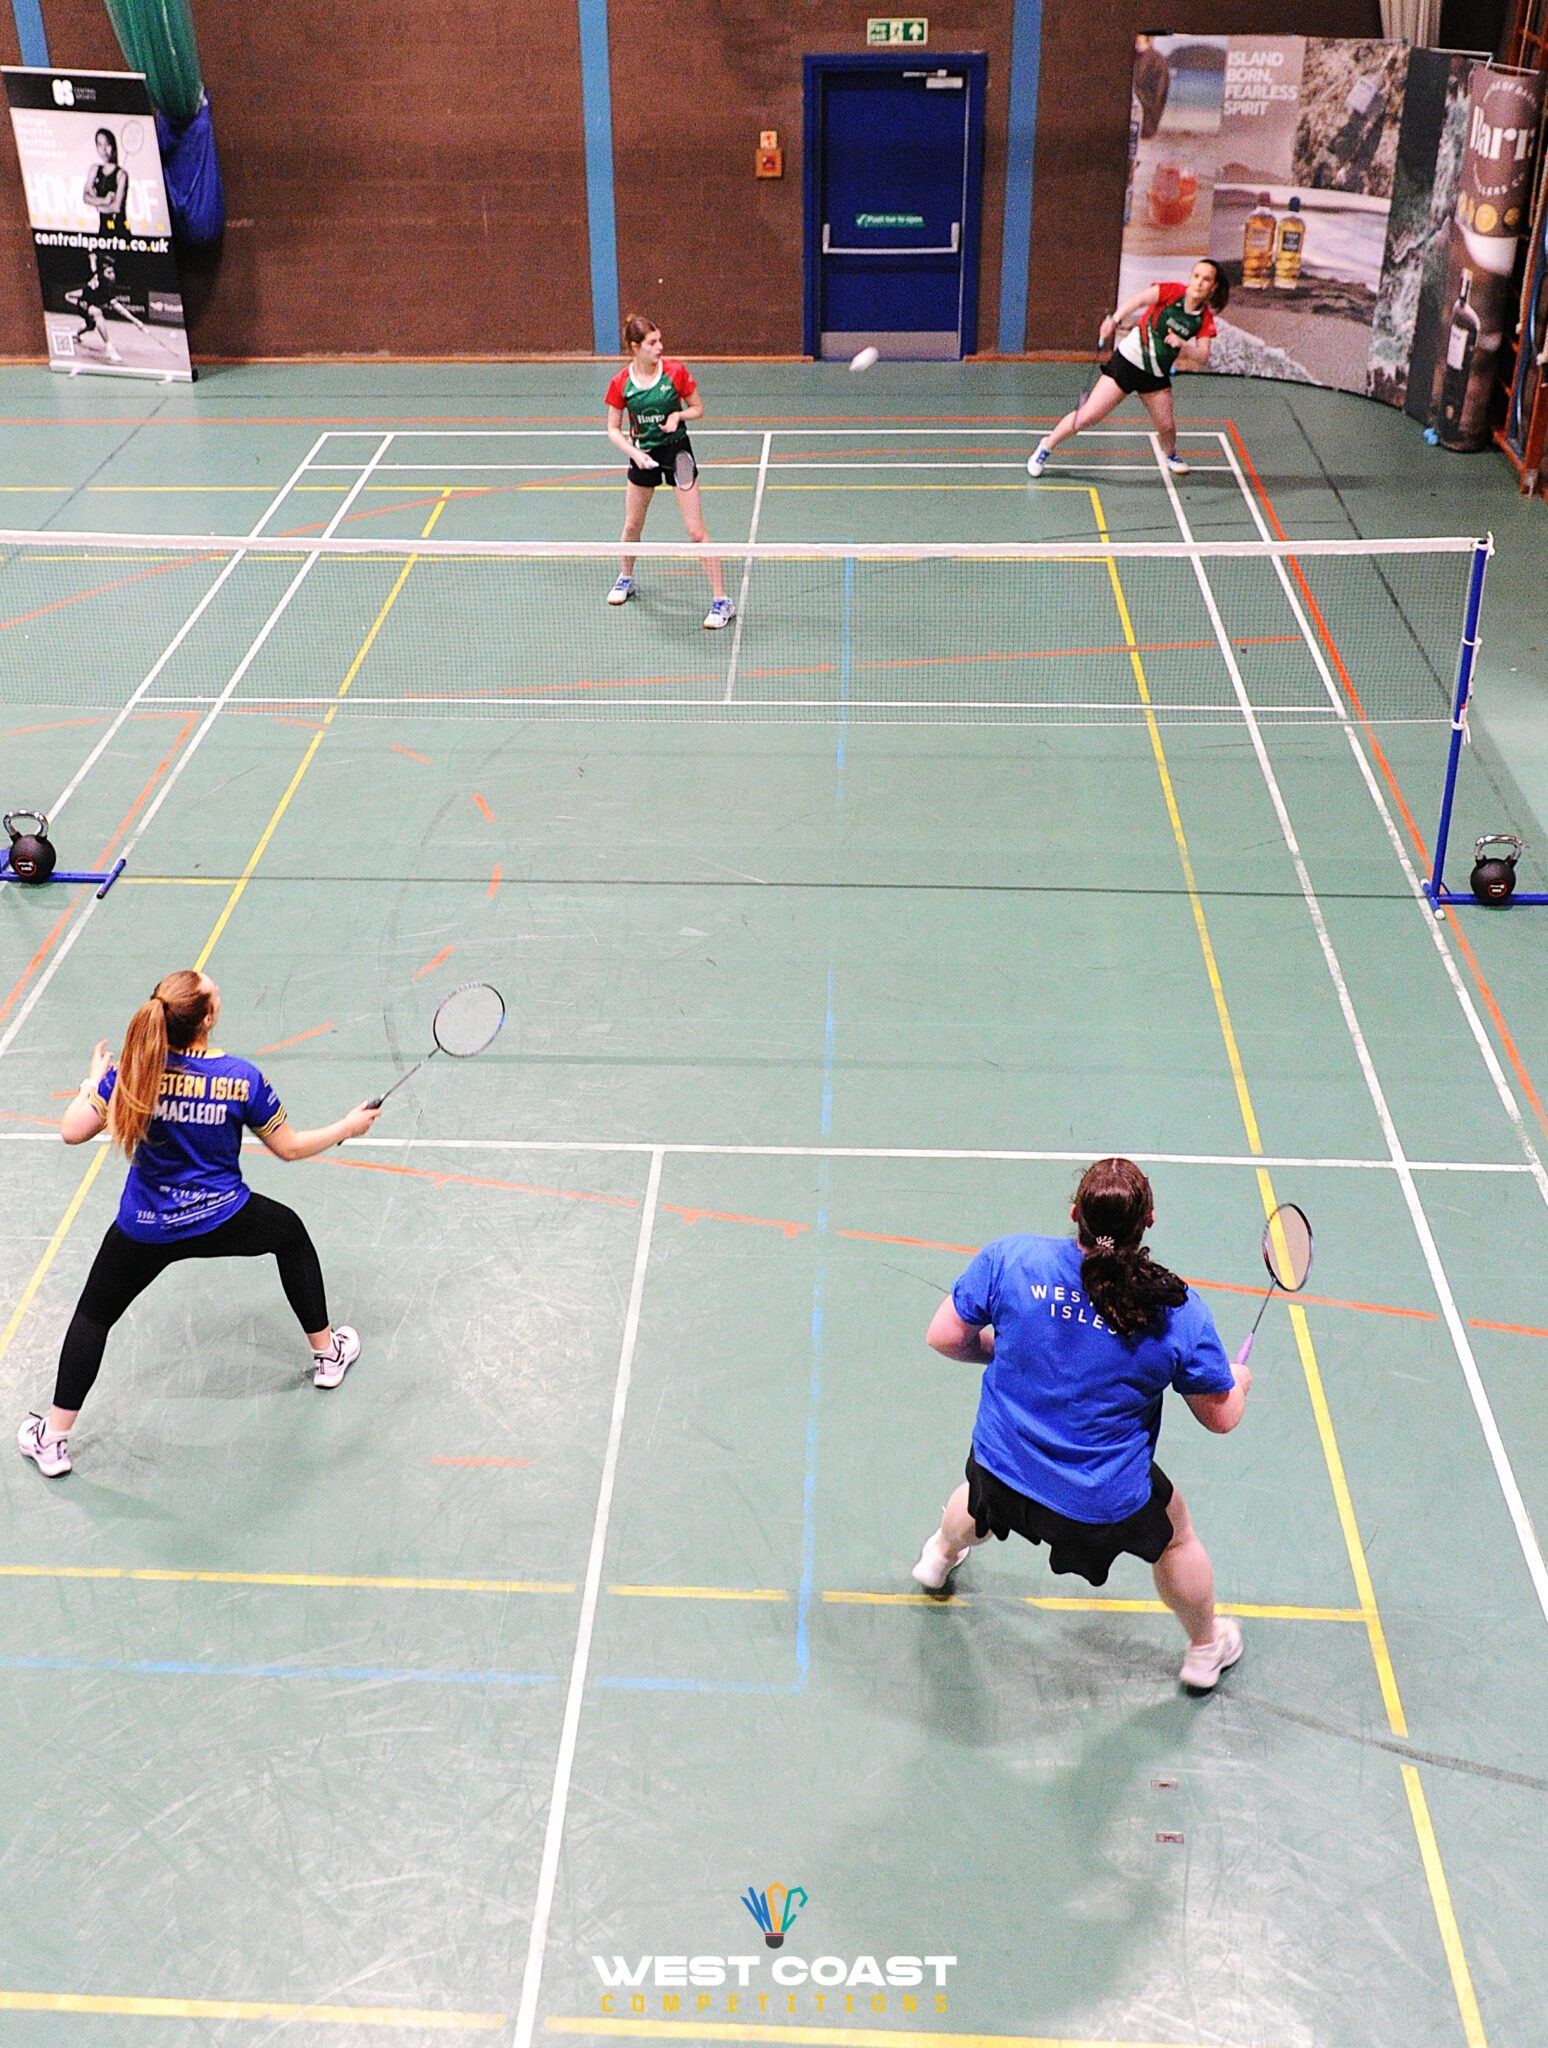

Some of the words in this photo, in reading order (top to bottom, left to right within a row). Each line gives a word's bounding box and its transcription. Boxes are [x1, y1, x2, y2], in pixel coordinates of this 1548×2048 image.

[1228, 51, 1284, 67] ISLAND
[1226, 67, 1273, 84] BORN,
[1225, 84, 1298, 101] FEARLESS
[1223, 100, 1269, 116] SPIRIT
[35, 232, 170, 254] centralsports.co.uk
[159, 1073, 207, 1099] STERN
[210, 1076, 251, 1103] ISLES
[154, 1100, 228, 1126] MACLEOD
